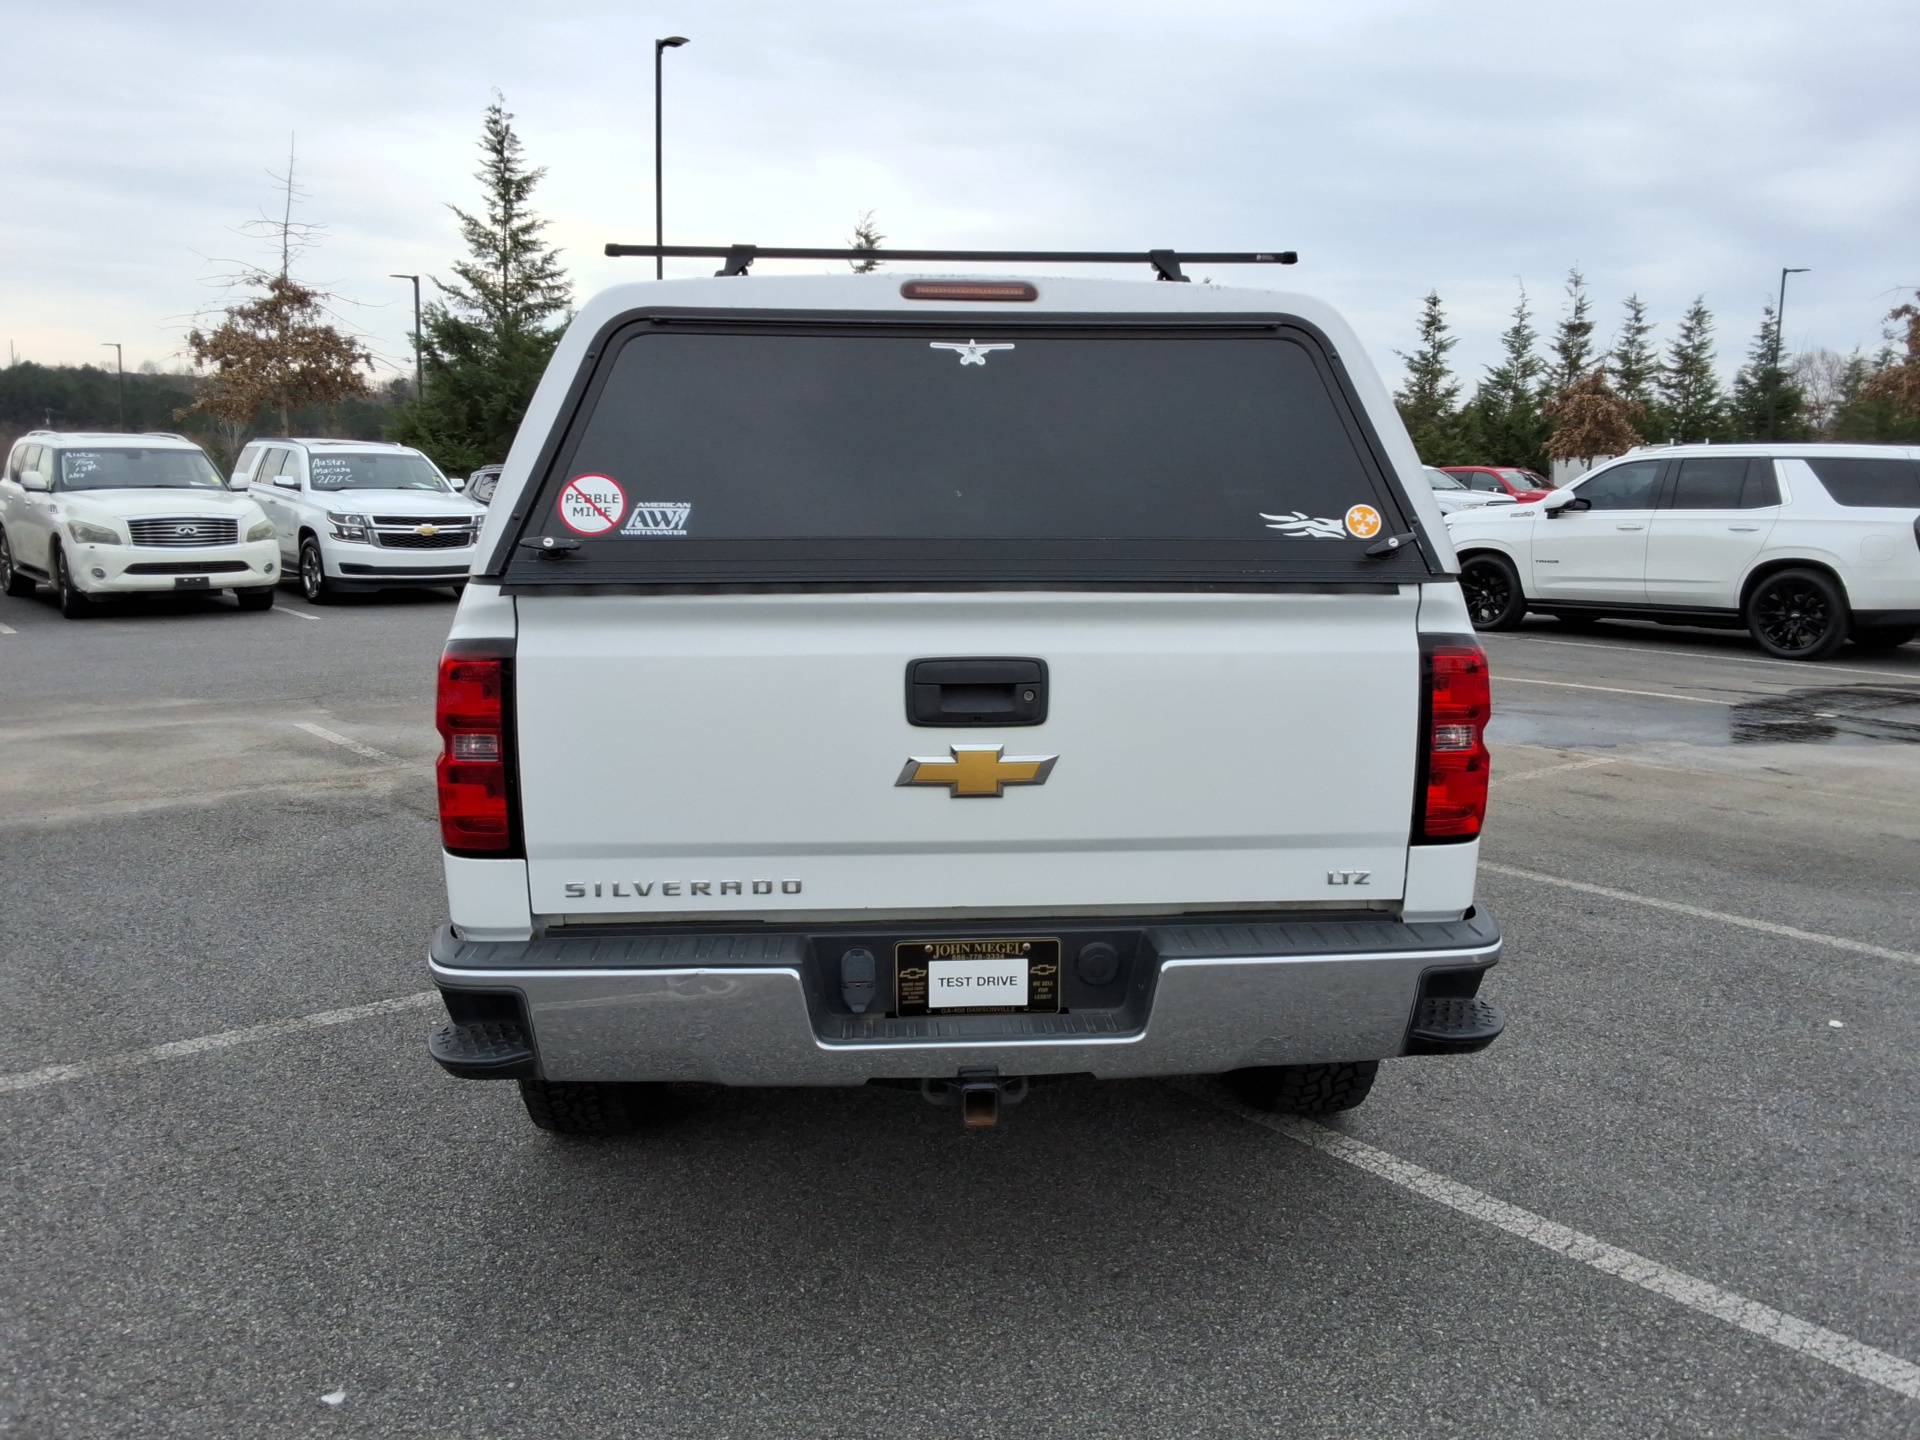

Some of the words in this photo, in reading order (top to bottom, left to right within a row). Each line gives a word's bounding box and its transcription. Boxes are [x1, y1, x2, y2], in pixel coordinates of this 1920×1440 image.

[1327, 870, 1371, 885] LTZ
[565, 878, 802, 898] SILVERADO
[933, 943, 971, 959] JOHN
[974, 942, 1024, 956] MEGEL
[938, 976, 972, 988] TEST
[976, 975, 1018, 987] DRIVE
